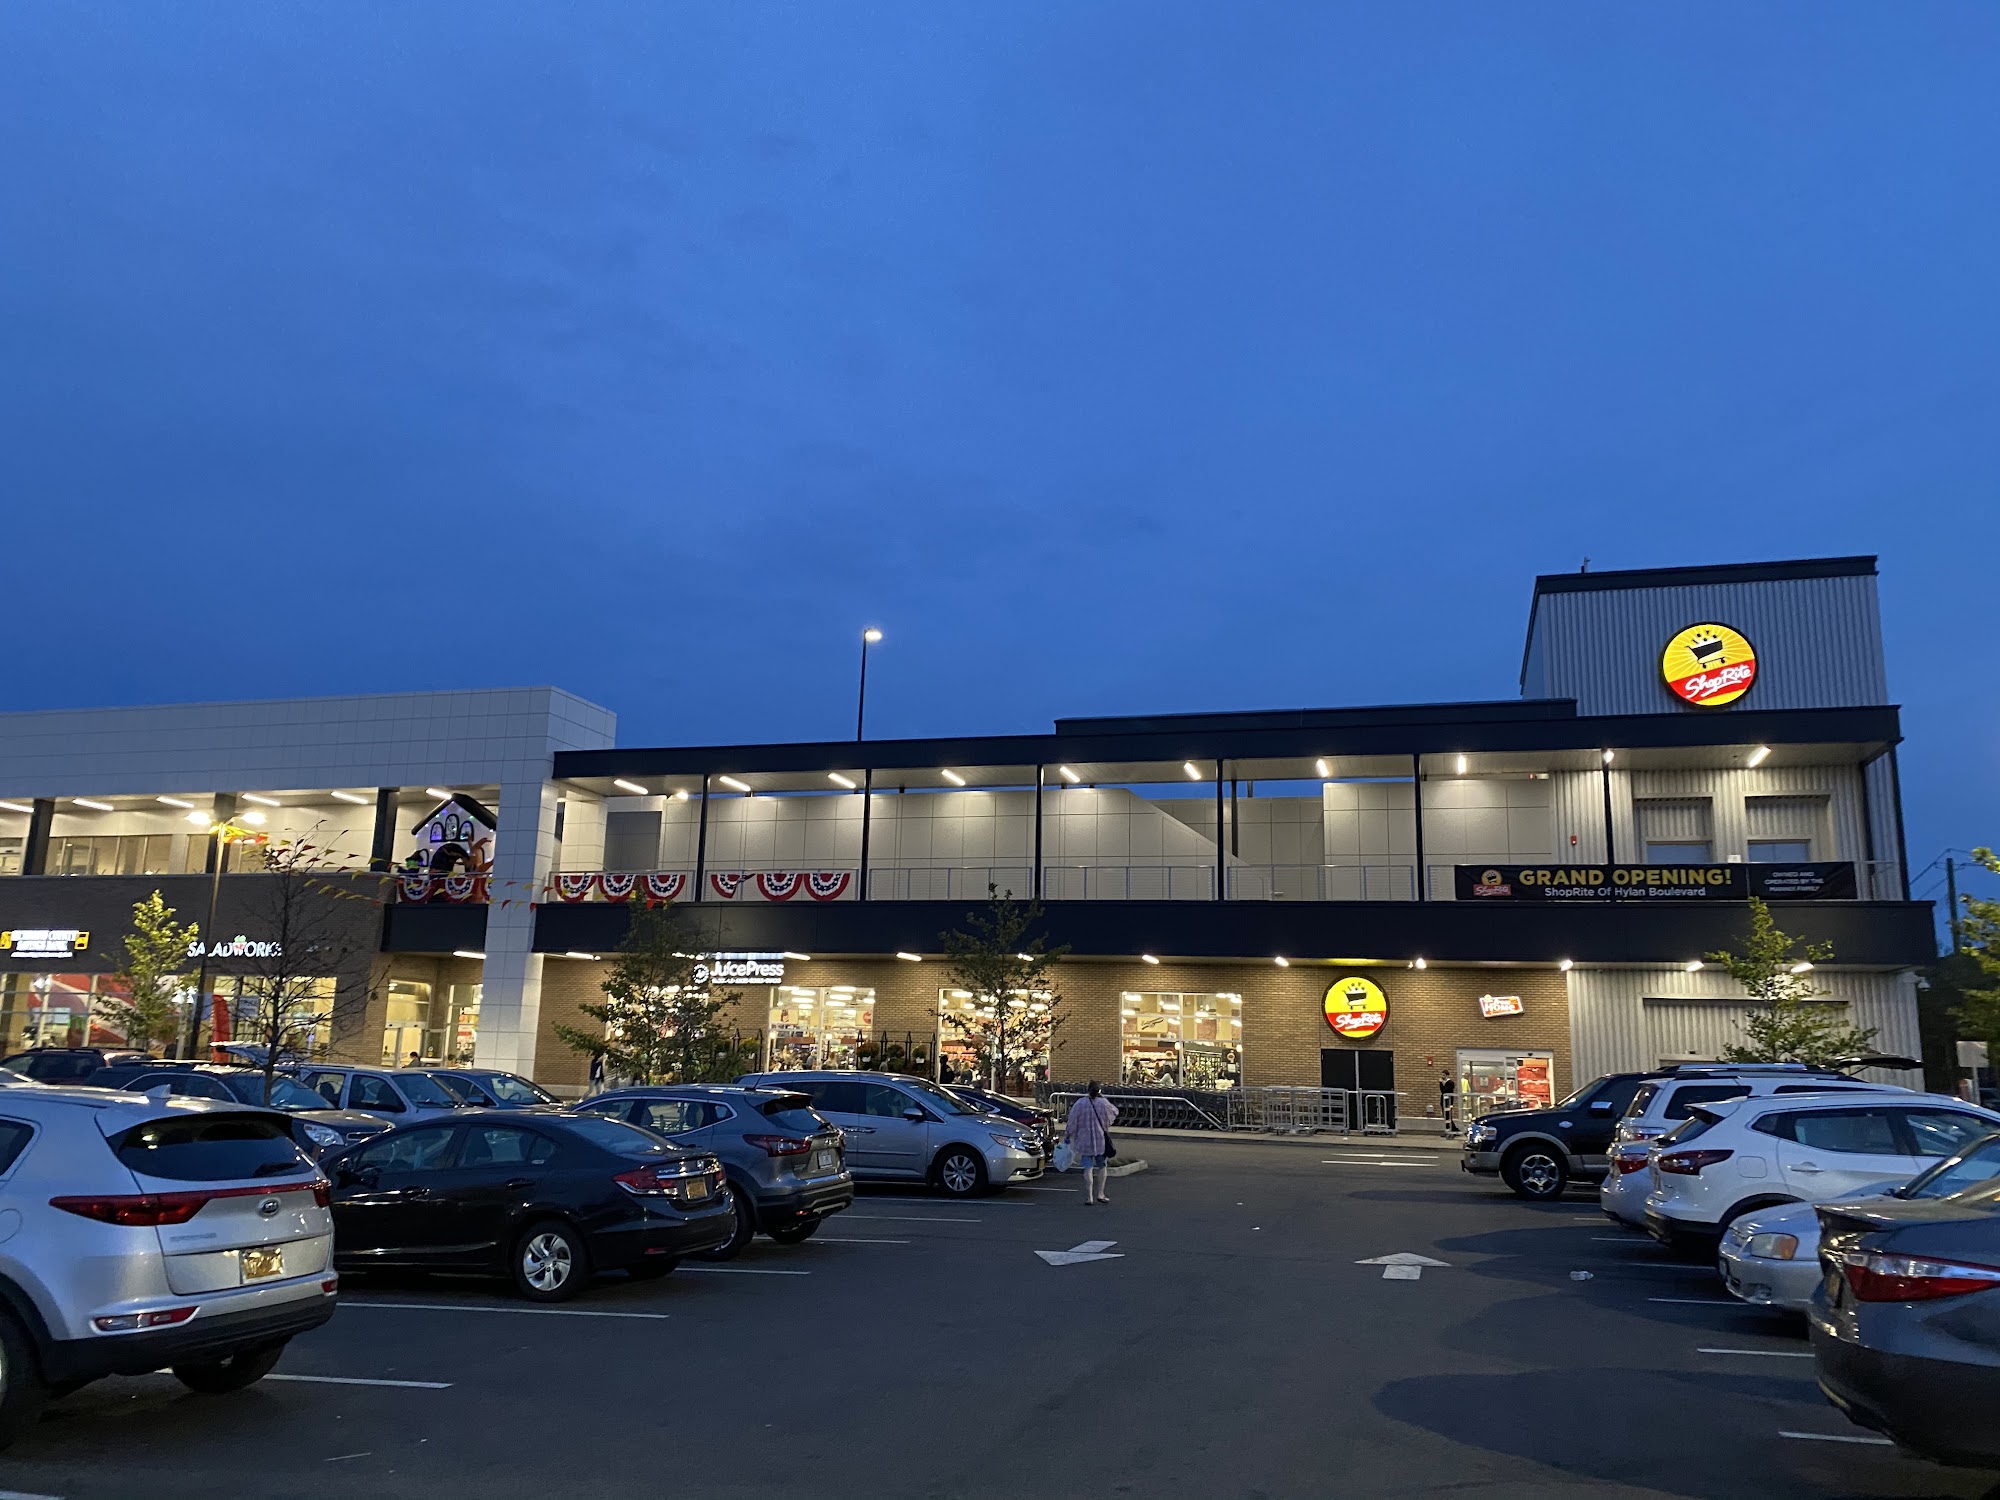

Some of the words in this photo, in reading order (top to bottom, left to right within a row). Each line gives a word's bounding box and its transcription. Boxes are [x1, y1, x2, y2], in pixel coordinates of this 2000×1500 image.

[1685, 664, 1752, 699] ShopRite
[1519, 869, 1604, 885] GRAND
[1612, 869, 1732, 885] OPENING!
[1544, 887, 1595, 898] ShopRite
[1597, 887, 1611, 897] Of
[1614, 886, 1646, 898] Hylan
[1648, 886, 1707, 897] Boulevard
[709, 960, 785, 977] JuicePress
[1335, 1012, 1383, 1030] ShopRite
